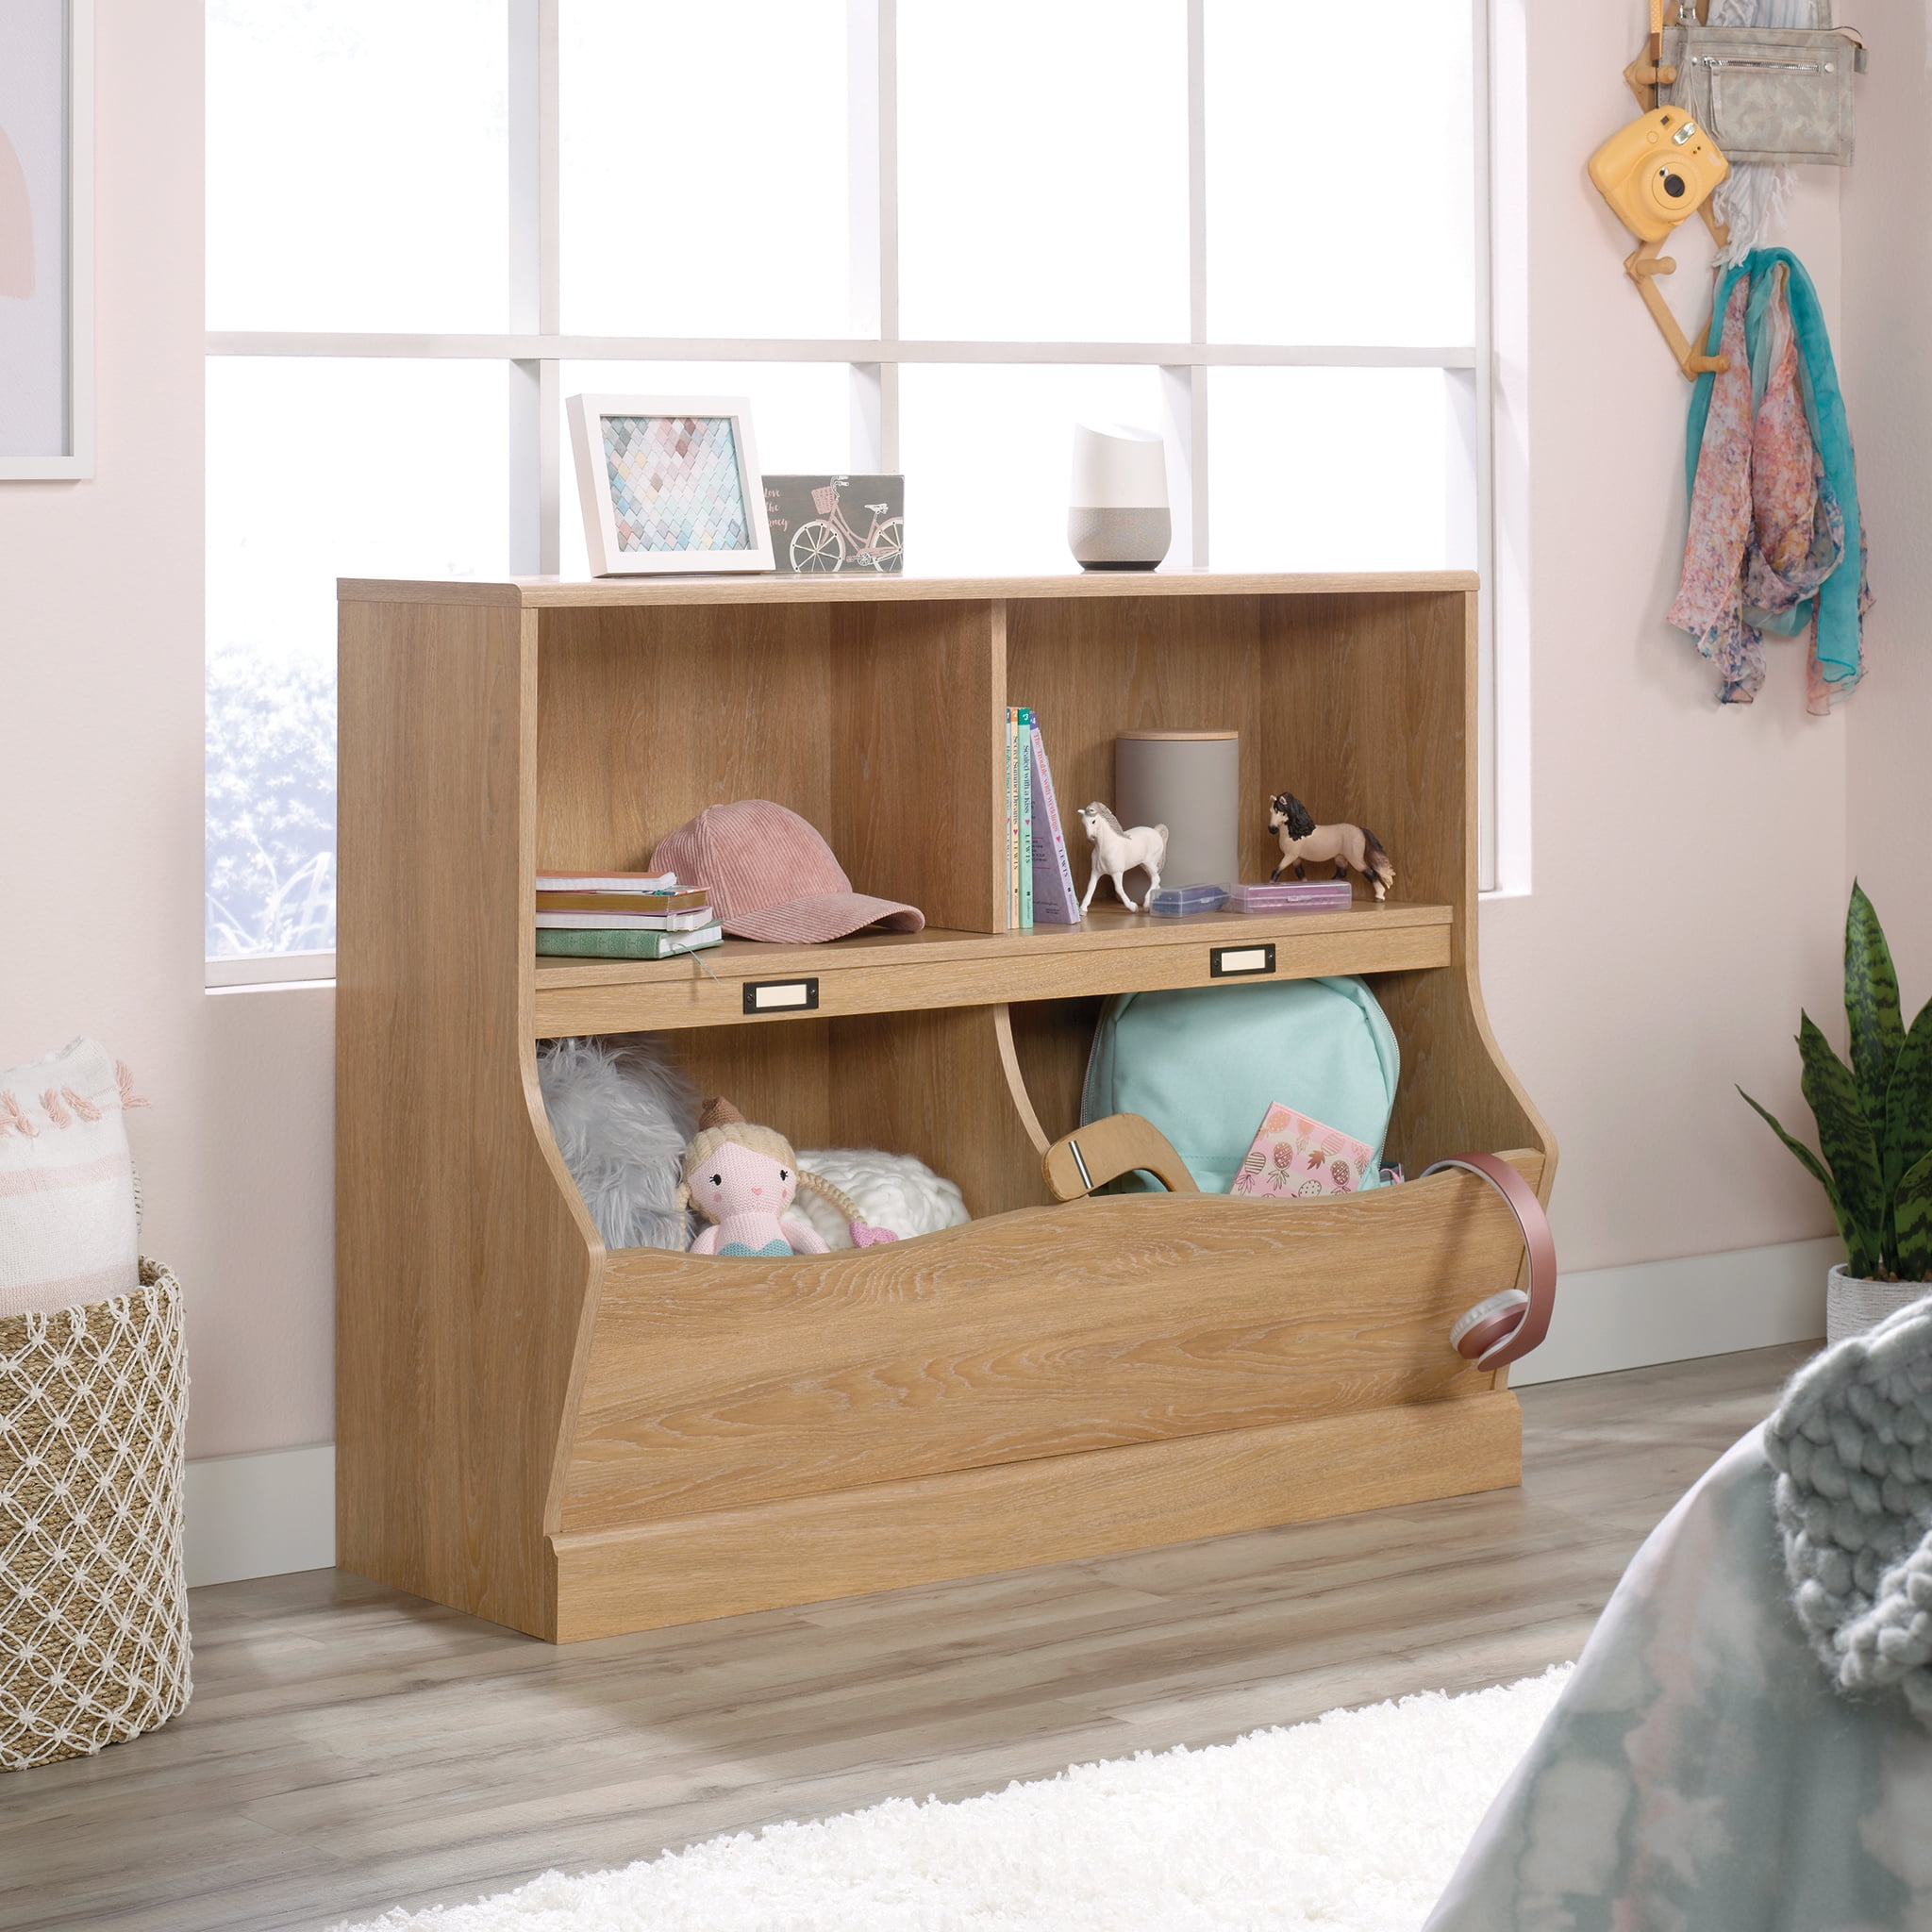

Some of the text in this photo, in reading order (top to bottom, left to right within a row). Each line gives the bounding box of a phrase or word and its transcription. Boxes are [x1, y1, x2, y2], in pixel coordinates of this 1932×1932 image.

[1037, 750, 1047, 776] Trouble
[1048, 795, 1058, 832] Weddings
[1059, 849, 1068, 877] LEWIS
